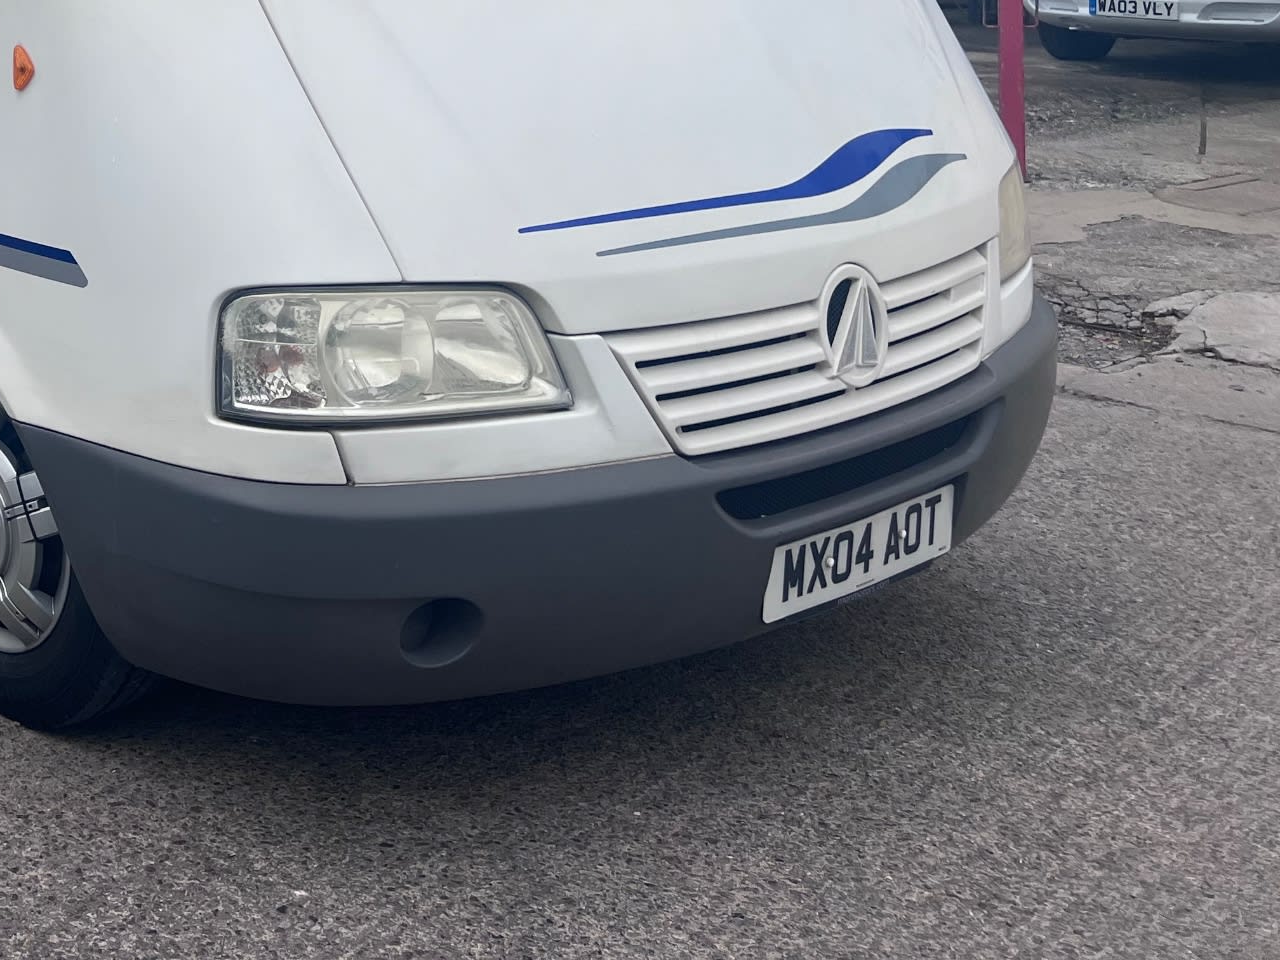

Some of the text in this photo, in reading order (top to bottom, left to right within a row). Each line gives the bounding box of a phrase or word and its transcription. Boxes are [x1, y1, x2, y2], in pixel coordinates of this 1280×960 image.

[1098, 0, 1174, 16] WA03 VLY
[781, 494, 942, 602] MX04 AOT
